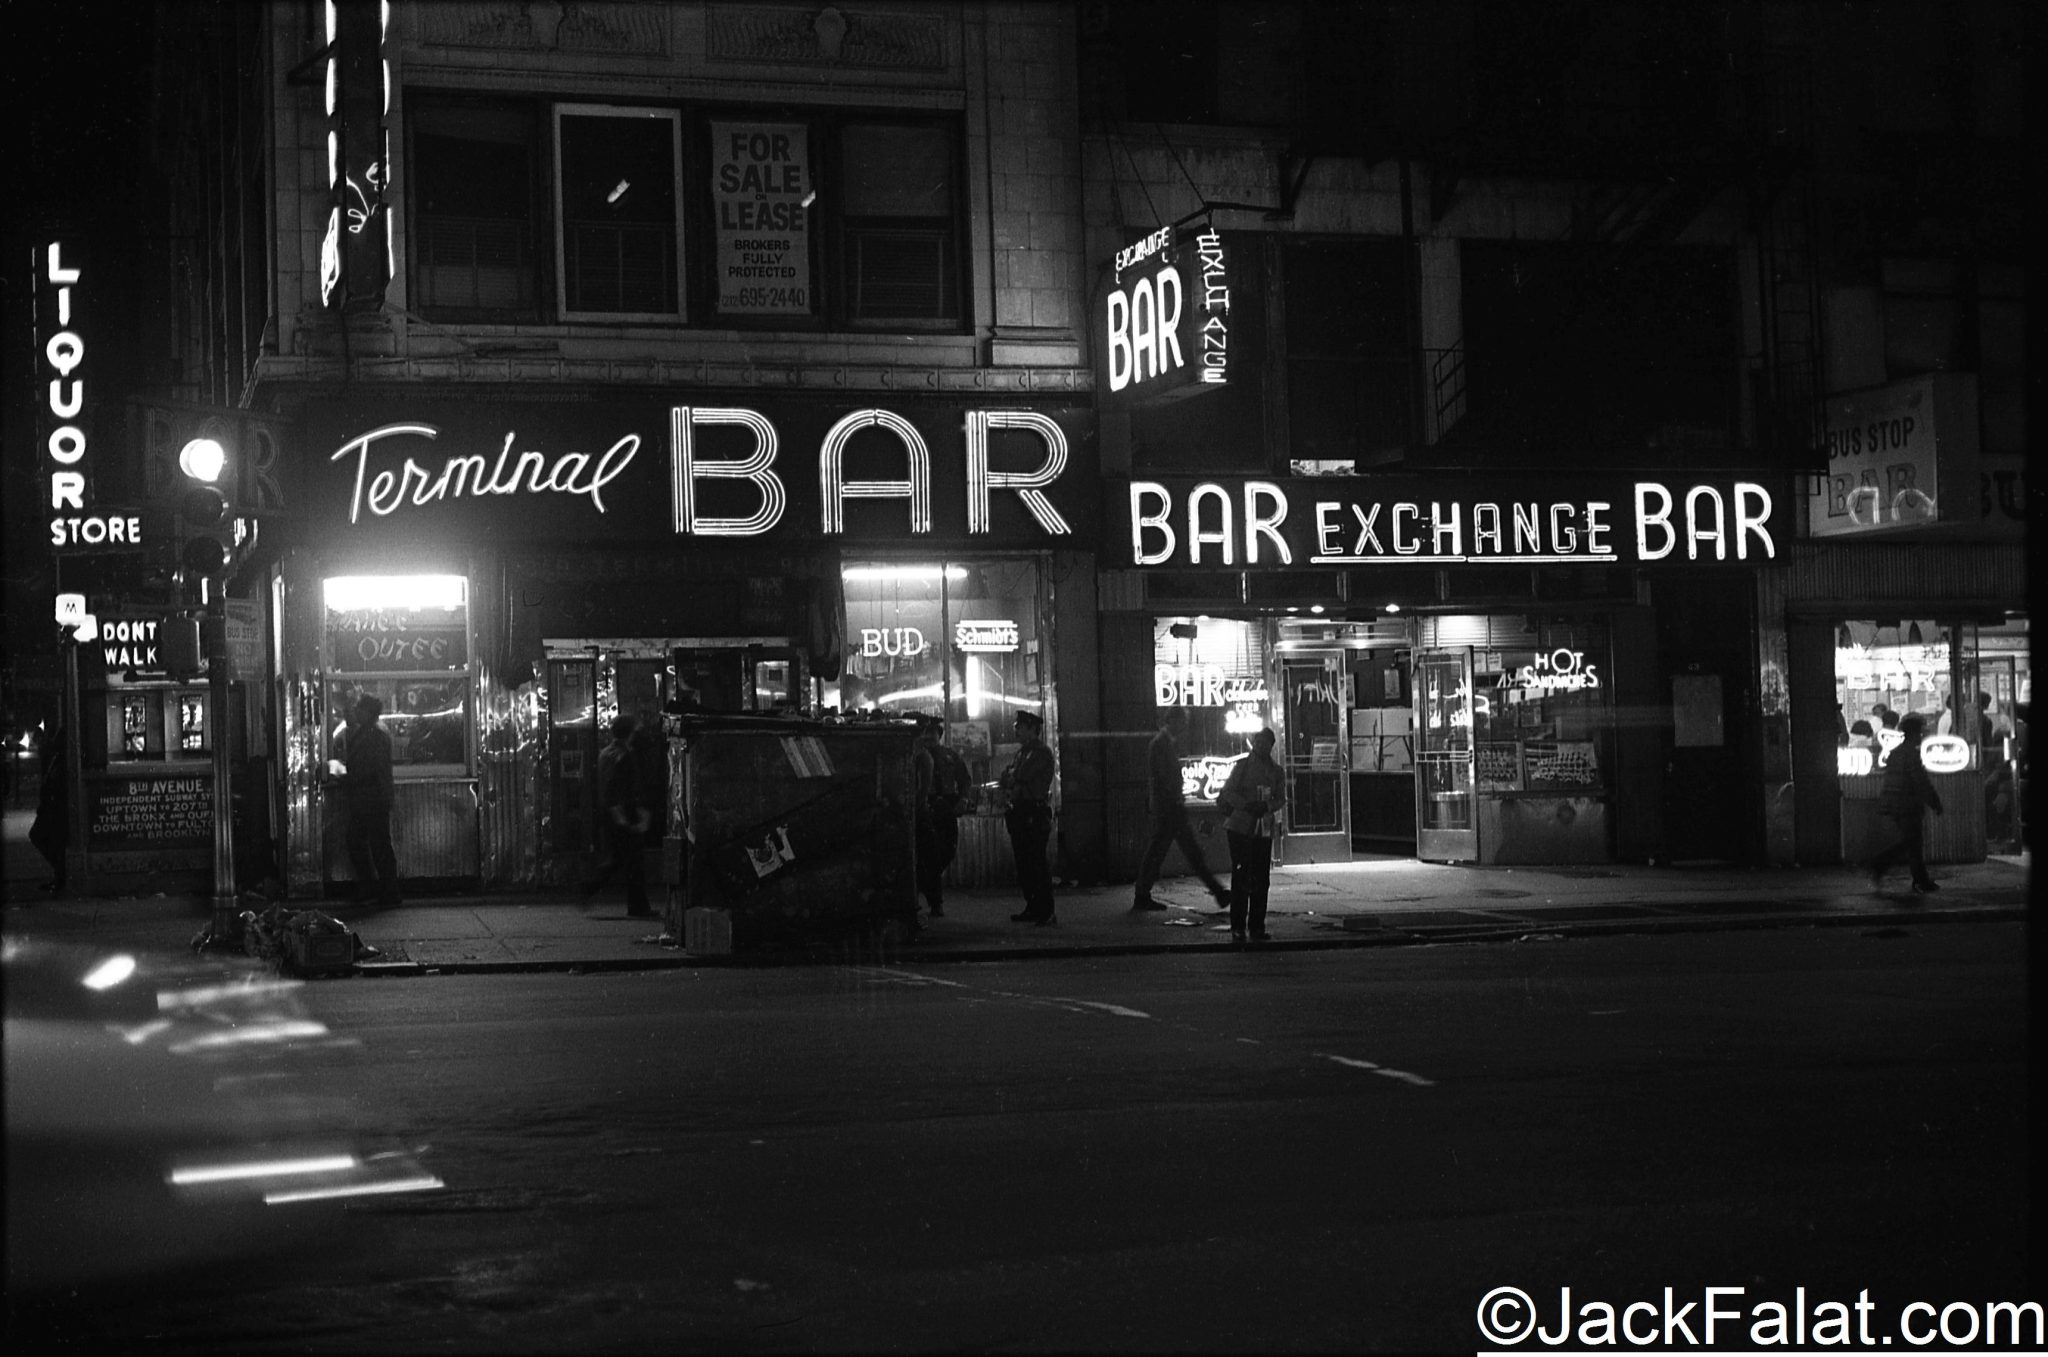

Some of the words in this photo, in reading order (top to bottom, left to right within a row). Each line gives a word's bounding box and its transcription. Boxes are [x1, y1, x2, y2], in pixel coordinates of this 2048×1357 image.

[731, 132, 791, 162] FOR
[720, 163, 801, 193] SALE
[721, 201, 804, 232] LEASE
[734, 239, 791, 251] BROKERS
[742, 252, 784, 264] FULLY
[728, 265, 796, 279] PROTECTED
[1197, 227, 1230, 384] EXCHANGE
[1107, 264, 1185, 393] BAR
[46, 241, 85, 509] LIQUOR
[1829, 425, 1862, 460] BUS
[1867, 416, 1915, 453] STOP
[331, 425, 642, 525] Terminal
[672, 405, 1072, 537] BAR
[1827, 463, 1917, 518] BAR
[50, 516, 142, 546] STORE
[1130, 480, 1294, 567] BAR
[1316, 500, 1614, 555] EXCHANGE
[1634, 481, 1777, 563] BAR
[103, 621, 158, 642] DONT
[861, 627, 924, 657] BUD
[104, 647, 158, 667] WALK
[358, 636, 448, 661] OUTEE
[1534, 648, 1584, 673] HOT
[1154, 663, 1226, 707] BAR
[1846, 662, 1936, 692] BAR
[100, 795, 161, 806] INDEPENDENT
[165, 793, 197, 802] SUBWAY
[151, 779, 204, 794] AVENUE
[98, 813, 119, 823] THE
[123, 812, 165, 822] BRONX
[169, 811, 185, 820] AND
[106, 804, 157, 815] UPTOWN
[93, 821, 163, 834] DOWNTOWN
[165, 821, 176, 829] TO
[178, 818, 215, 829] FULTO
[147, 828, 211, 841] BROOKLYN
